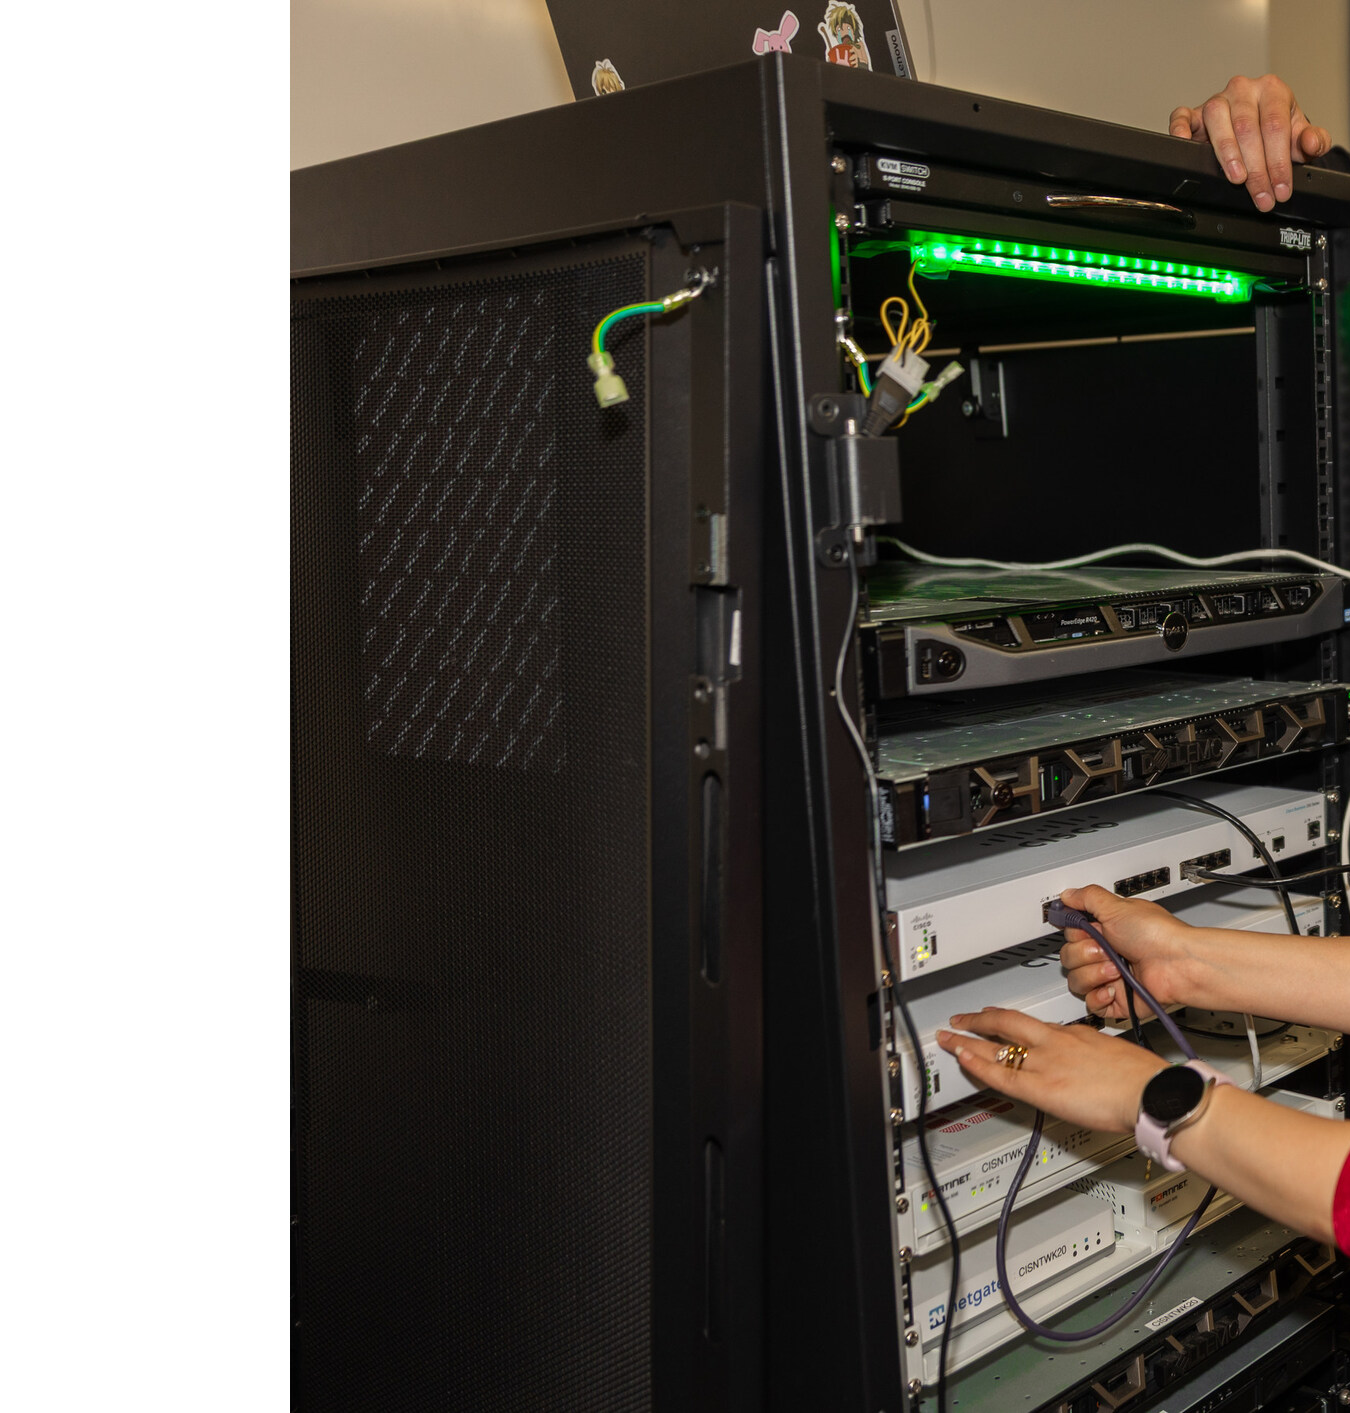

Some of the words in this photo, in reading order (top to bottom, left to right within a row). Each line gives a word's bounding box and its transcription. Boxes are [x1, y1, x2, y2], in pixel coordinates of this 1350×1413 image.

[880, 160, 899, 171] KVM
[900, 164, 928, 176] SWITCH
[902, 178, 926, 188] CONSOLE
[1060, 618, 1086, 626] PowerEdge
[1151, 1179, 1187, 1205] FORTINET
[1018, 1245, 1067, 1277] CISNTWK20
